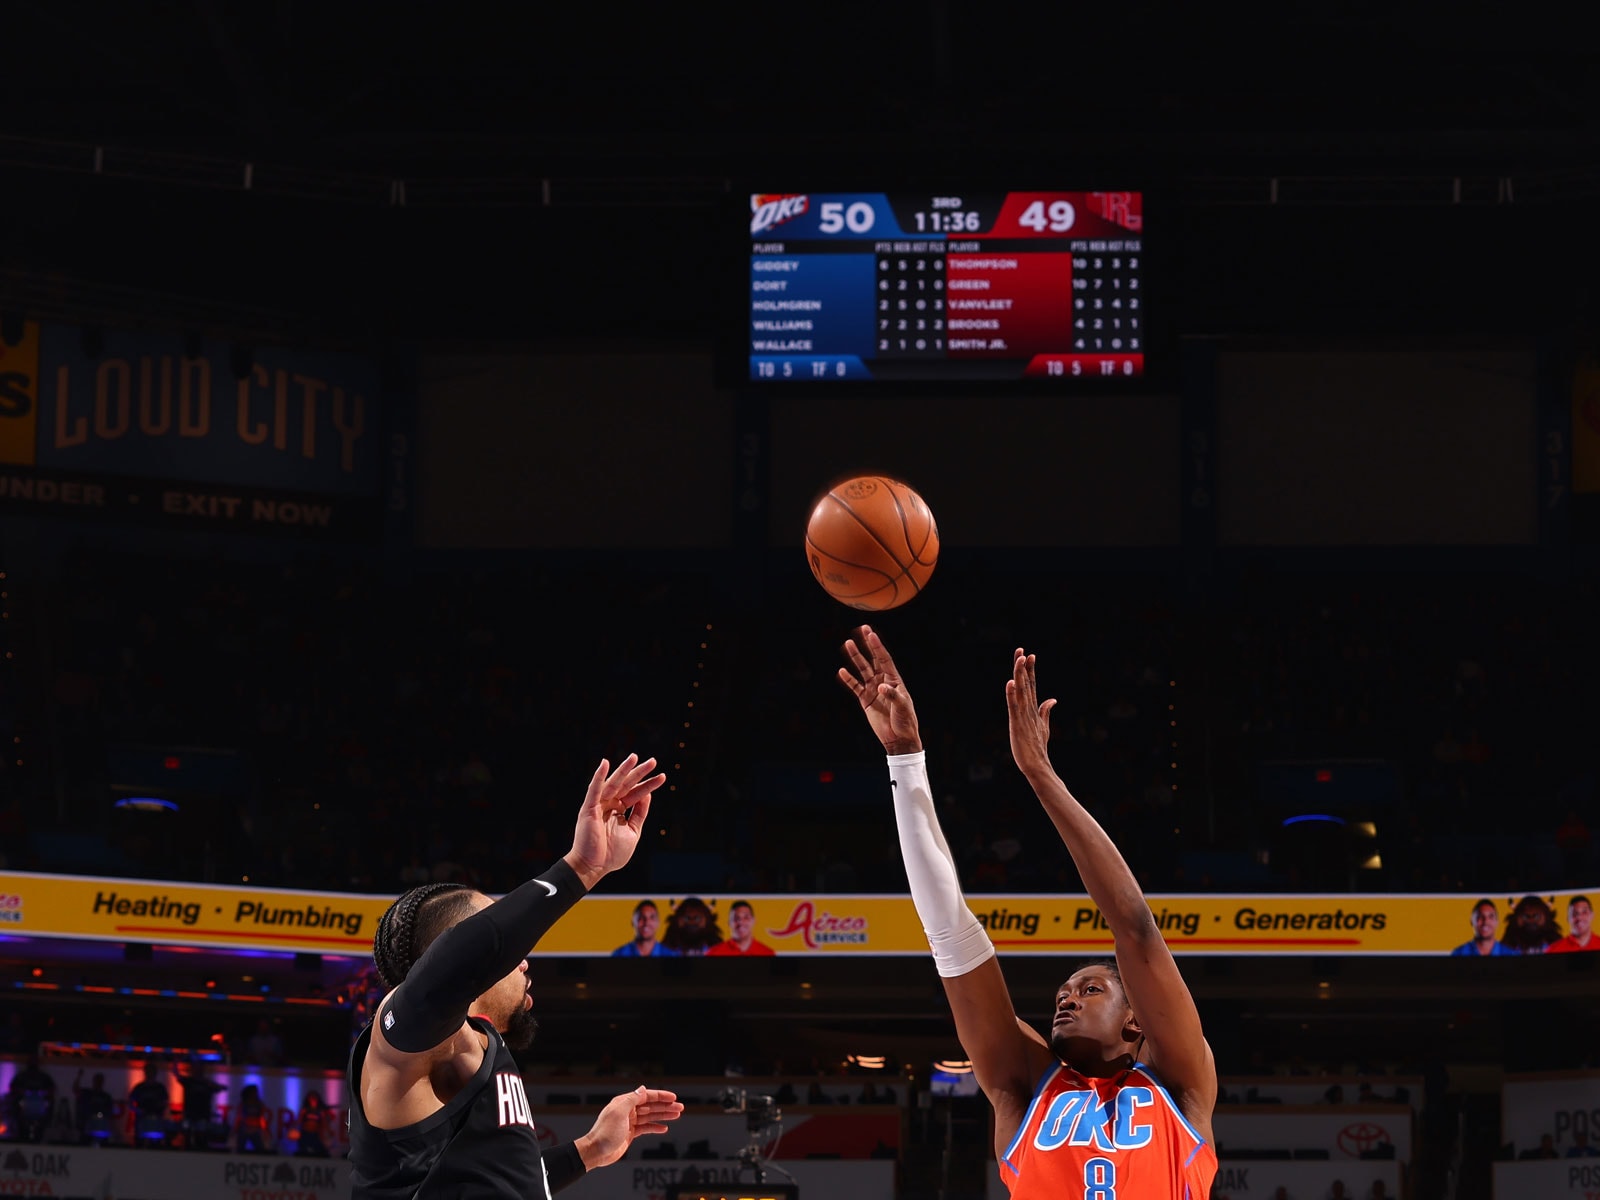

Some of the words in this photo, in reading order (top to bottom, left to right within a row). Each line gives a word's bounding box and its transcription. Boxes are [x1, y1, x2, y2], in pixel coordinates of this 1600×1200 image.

[931, 197, 962, 209] 3RD
[751, 195, 807, 234] OKC
[819, 202, 875, 233] 50
[914, 211, 980, 232] 11:36
[1018, 201, 1075, 232] 49
[753, 261, 799, 271] GIDDEY
[948, 259, 1017, 269] THOMPSON
[753, 281, 787, 291] DORT
[917, 280, 925, 291] 1
[948, 280, 990, 290] GREEN
[1093, 279, 1103, 290] 7
[1113, 279, 1120, 290] 1
[753, 300, 821, 311] HOLMGREN
[948, 300, 1013, 310] VANVLEET
[1112, 299, 1121, 310] 4
[753, 320, 813, 330] WILLIAMS
[879, 319, 889, 330] 7
[948, 320, 999, 330] BROOKS
[1074, 319, 1086, 330] 4
[1113, 319, 1120, 330] 1
[1130, 319, 1138, 330] 1
[753, 340, 813, 350] WALLACE
[899, 339, 906, 350] 1
[935, 339, 942, 350] 1
[948, 339, 987, 349] SMITH
[1074, 338, 1086, 349] 4
[1094, 338, 1102, 349] 1
[758, 362, 775, 377] TO
[783, 362, 793, 377] 5
[812, 362, 827, 377] TF
[1046, 361, 1063, 376] TO
[1071, 361, 1081, 376] 5
[1100, 361, 1115, 376] TF
[54, 355, 212, 450] LOUD
[236, 361, 366, 474] CITY
[162, 490, 242, 519] EXIT
[252, 499, 334, 529] NOW
[93, 891, 201, 926] Heating
[235, 901, 363, 936] Plumbing
[766, 901, 868, 950] Airco
[977, 908, 1040, 937] ating
[1074, 908, 1200, 935] Pling
[1233, 907, 1387, 932] Generators
[814, 933, 868, 944] SERVICE
[1033, 1086, 1154, 1153] OKC
[32, 1154, 70, 1177] OAK
[225, 1162, 271, 1185] POST
[300, 1166, 337, 1189] OAK
[633, 1167, 677, 1190] POST
